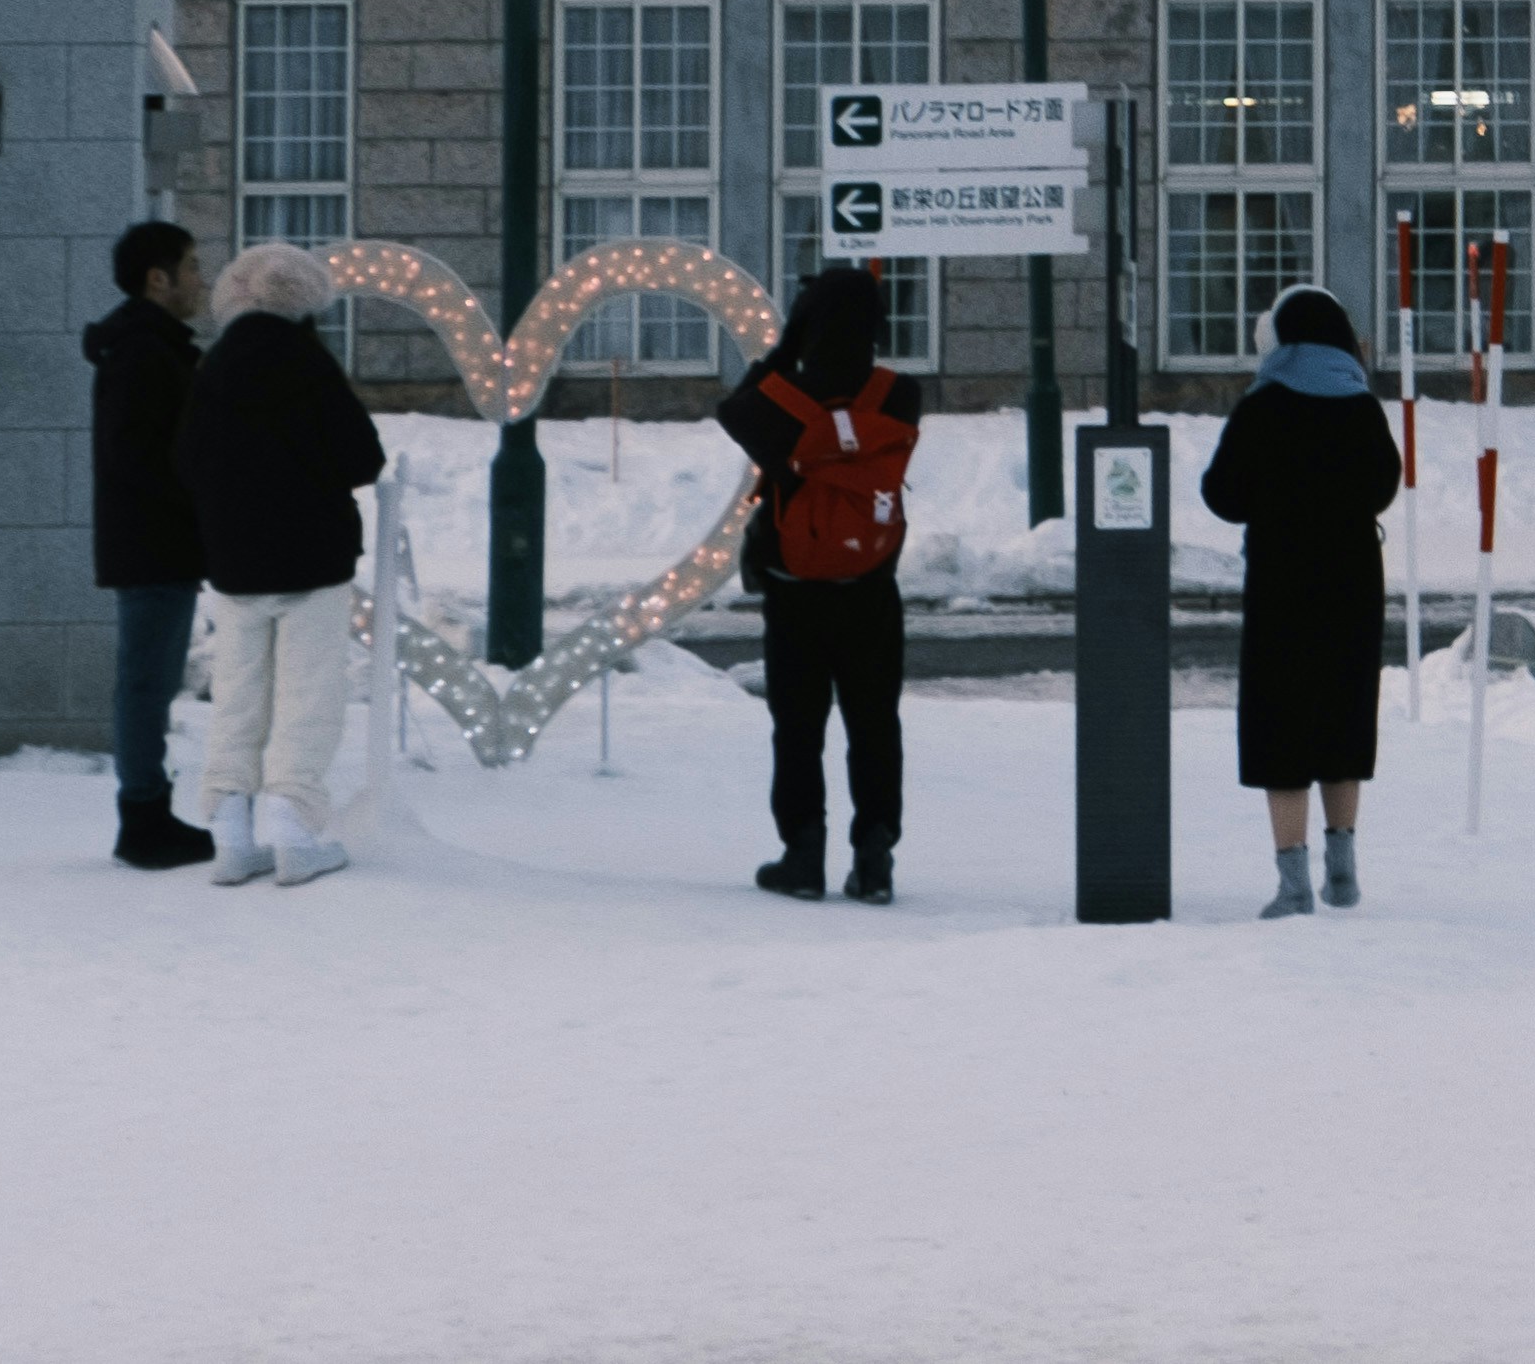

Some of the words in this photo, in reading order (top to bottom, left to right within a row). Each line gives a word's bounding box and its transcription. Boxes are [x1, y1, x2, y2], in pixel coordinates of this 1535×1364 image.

[890, 97, 1064, 122] パノラマロード方面
[890, 129, 950, 140] Panorama
[953, 128, 986, 139] Road
[988, 128, 1015, 138] Area
[891, 186, 1064, 210] 新栄の丘展望公園
[1026, 213, 1053, 224] Park
